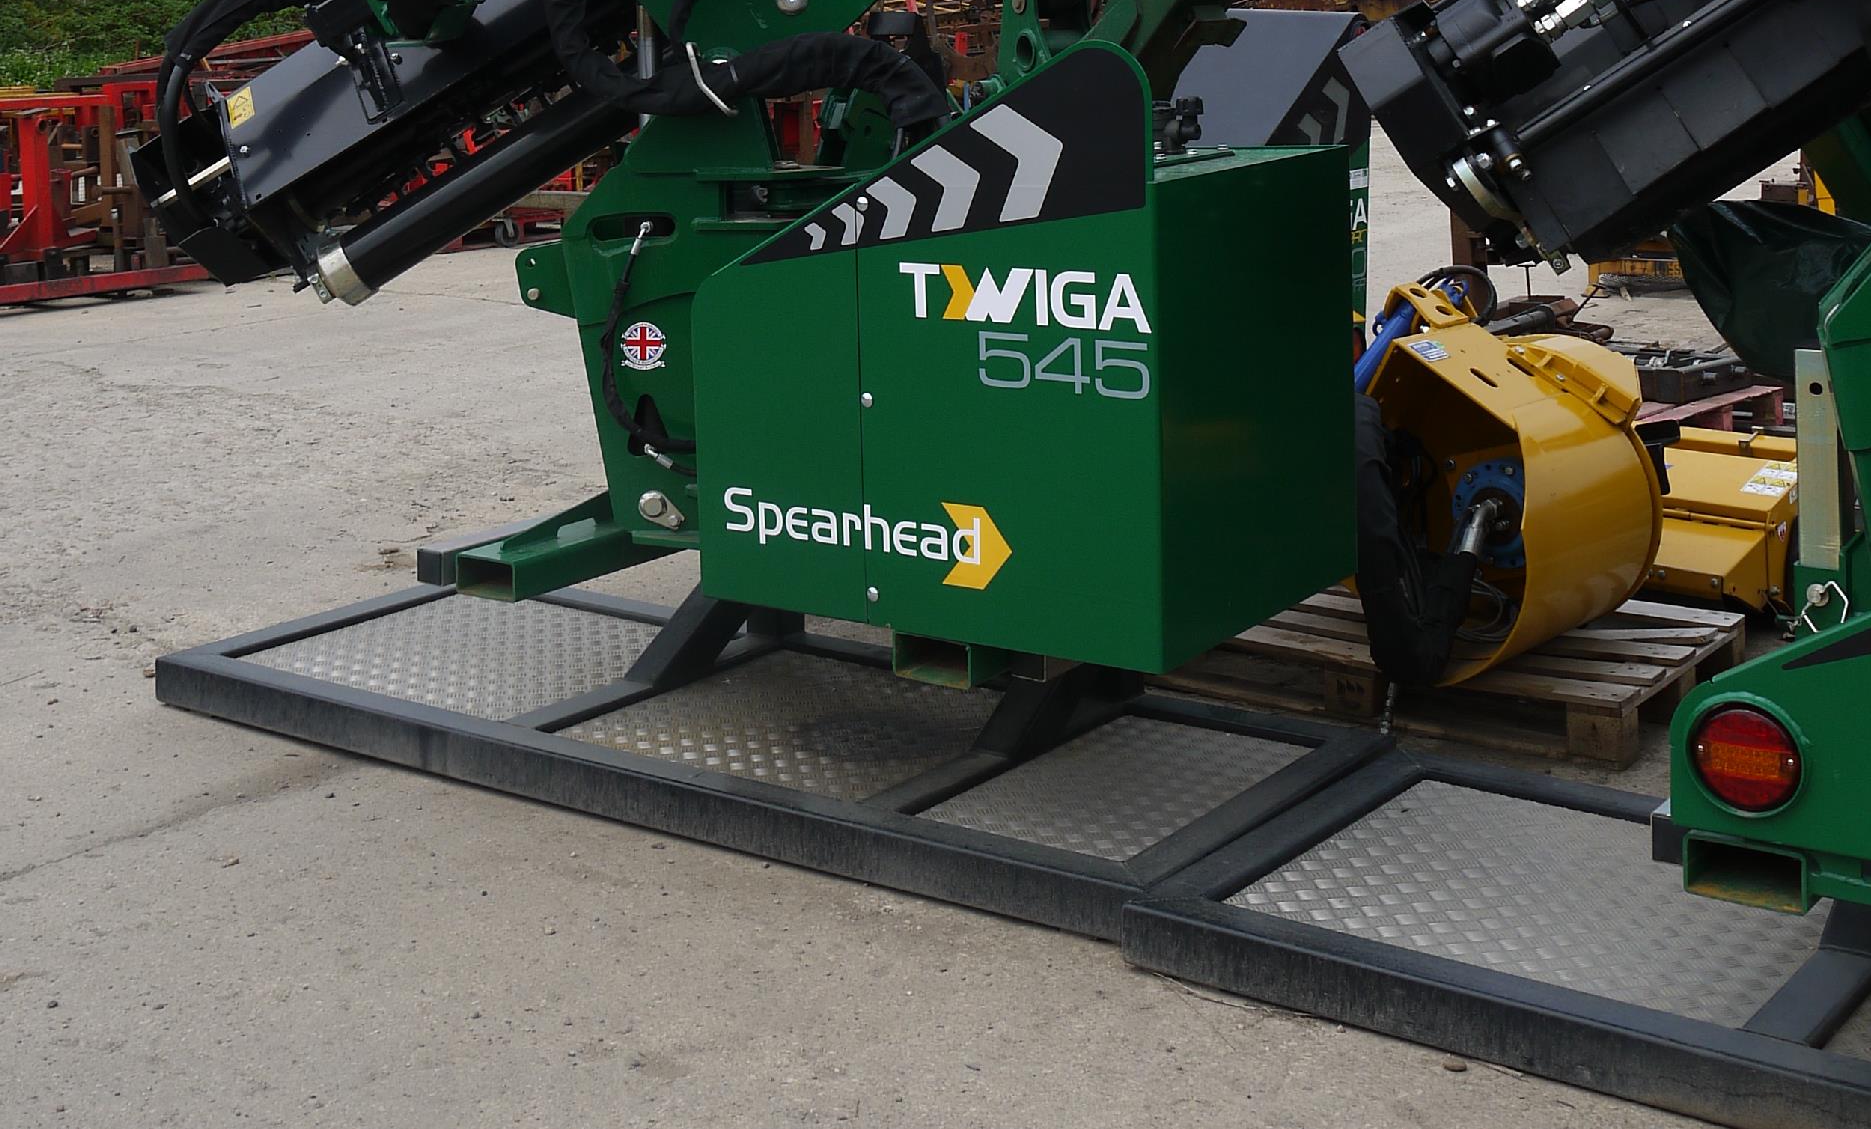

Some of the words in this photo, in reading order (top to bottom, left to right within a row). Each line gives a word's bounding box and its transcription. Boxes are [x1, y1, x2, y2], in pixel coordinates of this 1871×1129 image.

[899, 261, 1151, 333] TWIGA
[979, 333, 1150, 399] 545
[724, 487, 981, 565] Spearhead
